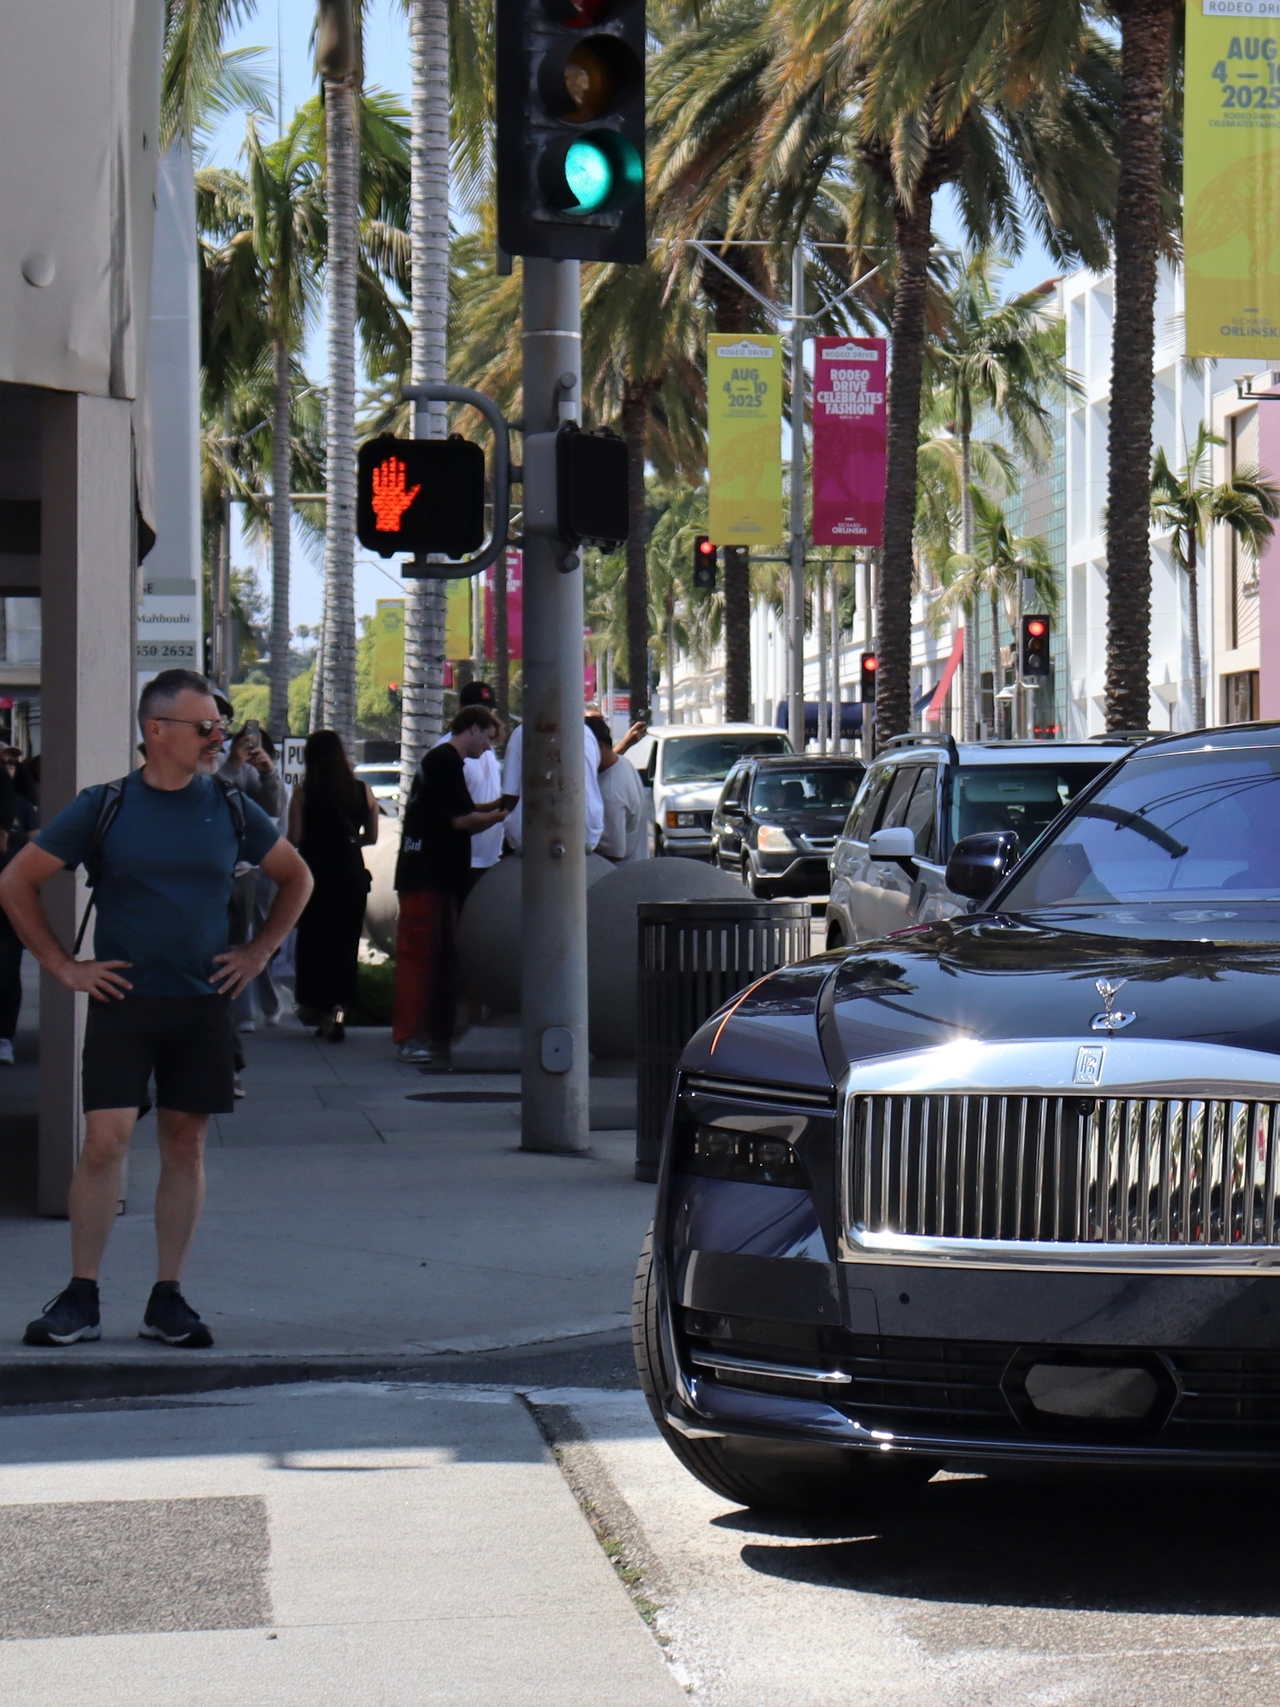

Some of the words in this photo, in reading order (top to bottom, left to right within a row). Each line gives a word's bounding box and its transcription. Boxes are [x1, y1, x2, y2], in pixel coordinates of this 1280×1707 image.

[1209, 2, 1253, 12] RODEO
[1227, 36, 1277, 60] AUG
[1211, 60, 1227, 83] 4
[1209, 119, 1253, 127] CELEBRATES
[1231, 317, 1271, 326] RICHARD
[731, 368, 759, 381] AUG
[830, 368, 870, 381] RODEO
[722, 381, 732, 394] 4
[754, 381, 768, 395] 10
[833, 380, 867, 392] DRIVE
[728, 394, 762, 407] 2025
[816, 391, 883, 405] CELEBRATES
[825, 403, 875, 415] FASHION
[832, 526, 867, 534] ORLINSKI
[161, 645, 194, 656] 2652
